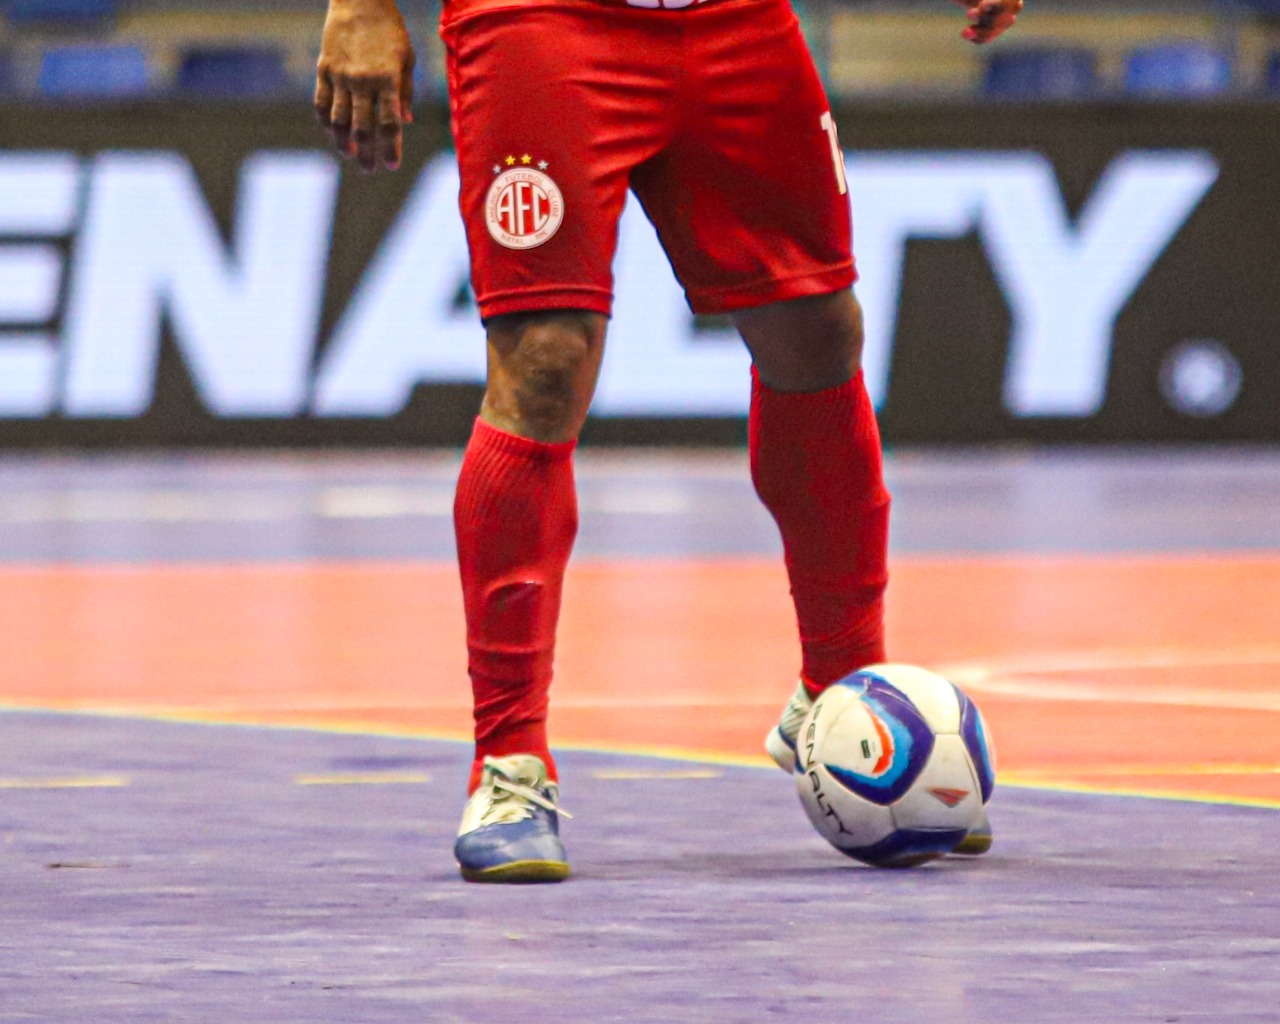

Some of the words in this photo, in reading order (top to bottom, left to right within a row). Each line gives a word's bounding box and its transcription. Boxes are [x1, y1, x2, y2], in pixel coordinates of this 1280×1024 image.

[820, 110, 847, 195] 1
[504, 173, 544, 185] FUTEBOL
[496, 181, 550, 236] AFC
[547, 189, 560, 218] CLUBE
[500, 233, 526, 245] NATAL
[806, 704, 854, 836] PENALTY
